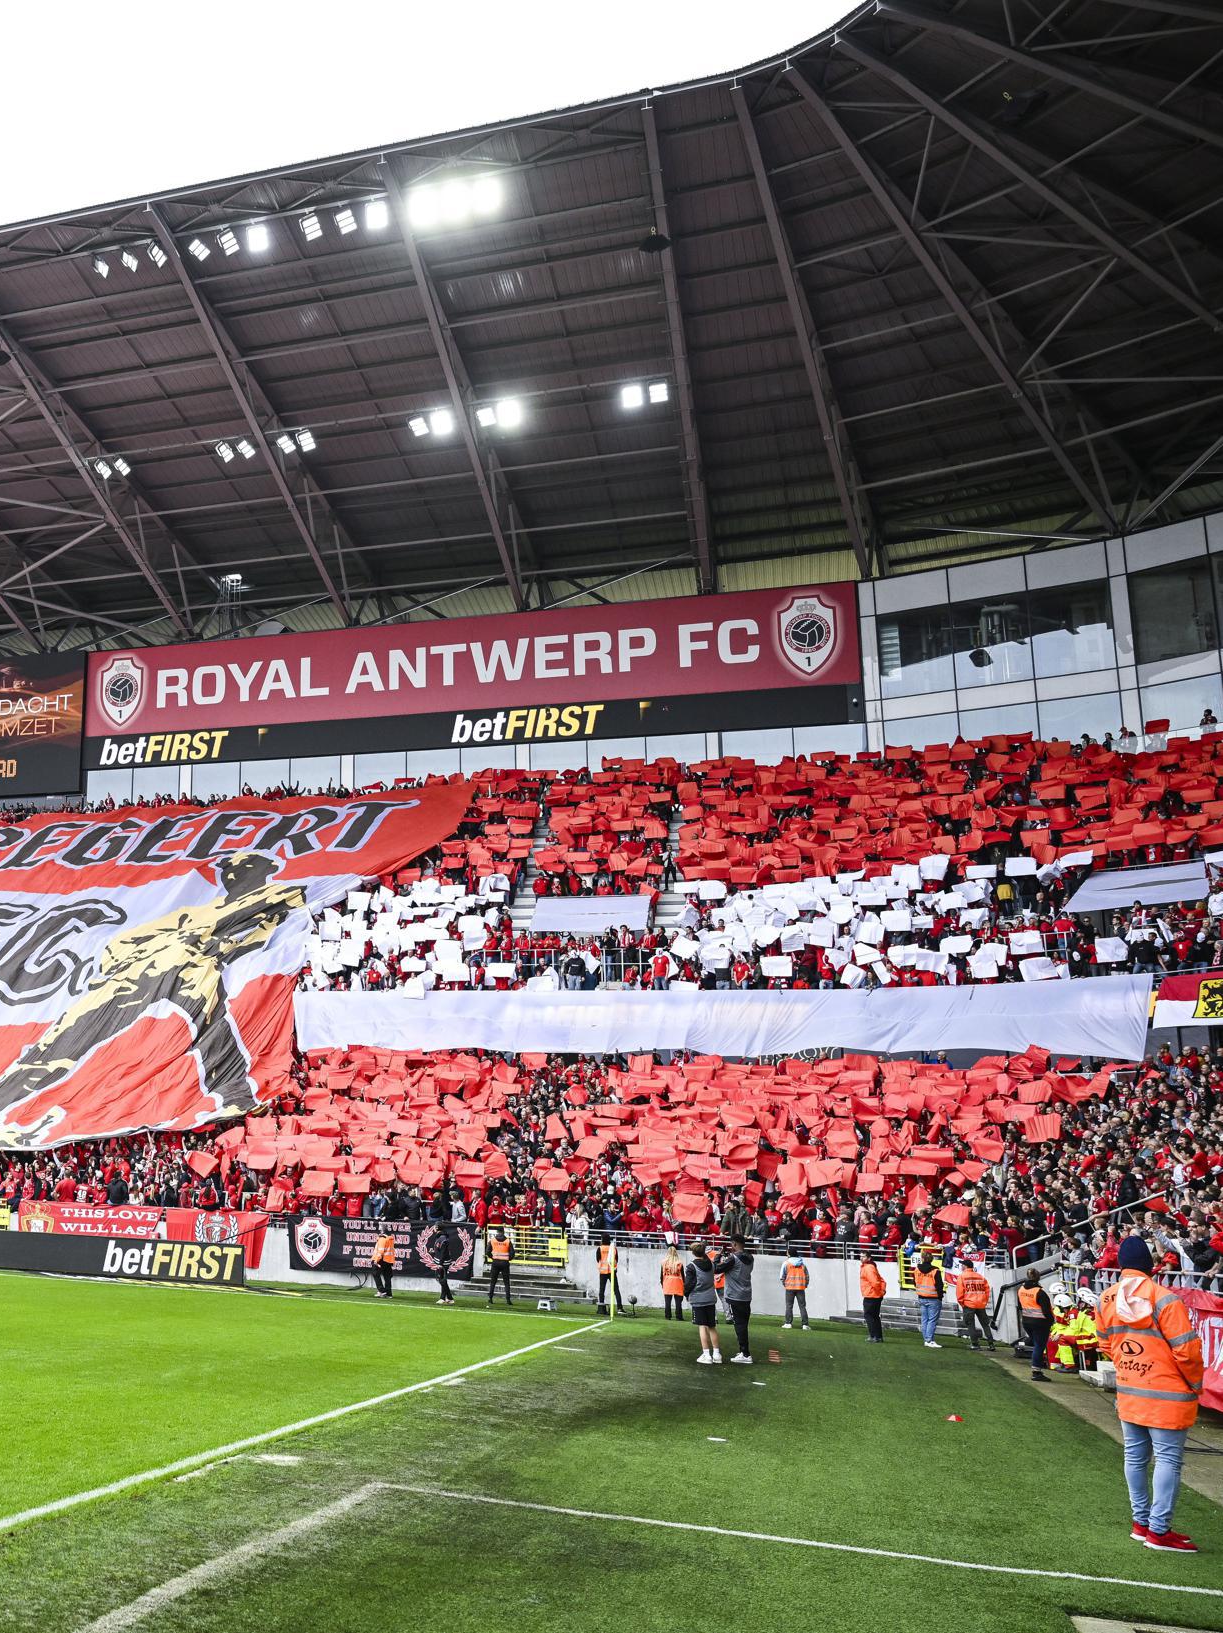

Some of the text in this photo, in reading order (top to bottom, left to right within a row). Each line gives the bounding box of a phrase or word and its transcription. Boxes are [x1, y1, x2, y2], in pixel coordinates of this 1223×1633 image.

[155, 656, 330, 709] ROYAL
[344, 627, 657, 694] ANTWERP
[678, 618, 760, 668] FC
[451, 704, 604, 743] betFIRST
[98, 730, 229, 765] betFIRST
[59, 1222, 109, 1233] WILL
[60, 1207, 159, 1222] THIS LOVE
[102, 1240, 242, 1280] betFIRST
